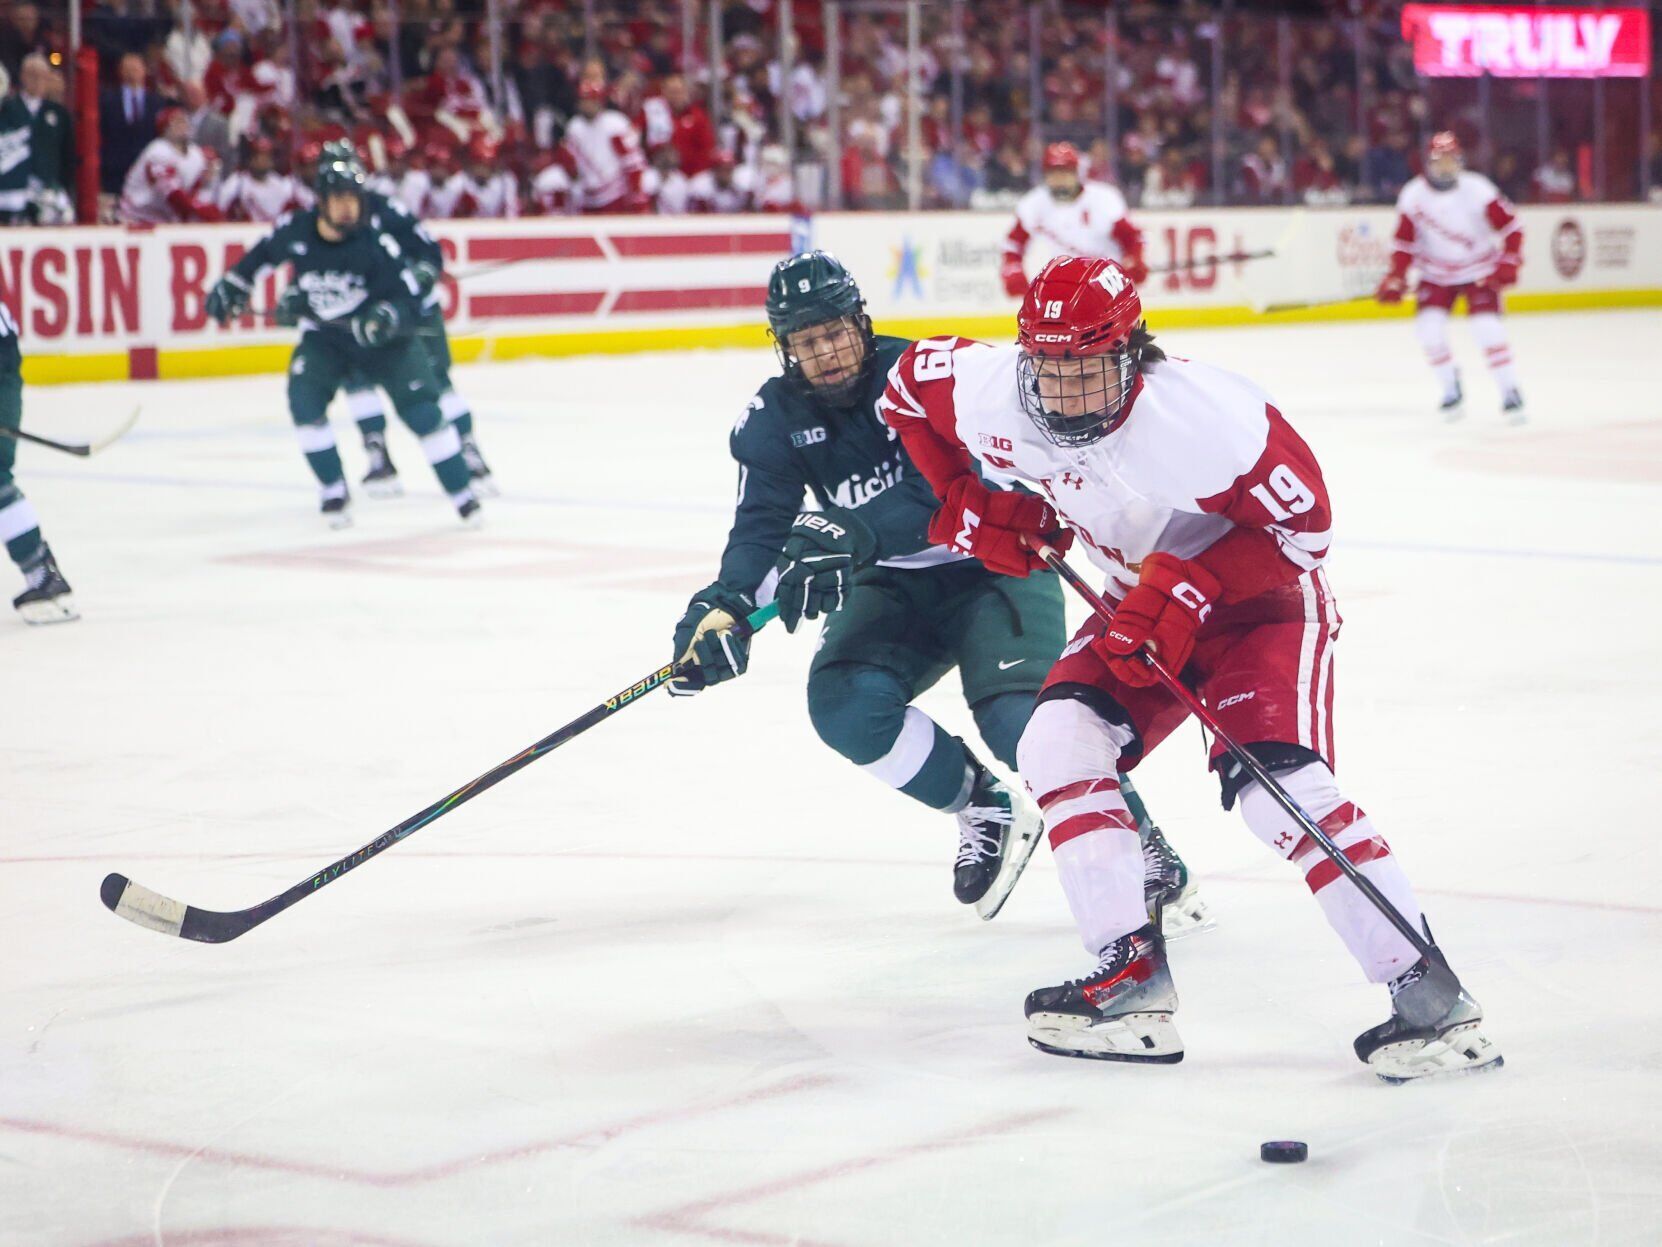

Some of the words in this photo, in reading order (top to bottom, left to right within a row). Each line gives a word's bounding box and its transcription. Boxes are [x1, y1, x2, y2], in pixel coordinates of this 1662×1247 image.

[1429, 12, 1621, 69] TRULY
[798, 278, 811, 293] 9
[1044, 301, 1063, 319] 19
[1035, 334, 1072, 344] CCM
[913, 336, 958, 382] 19
[1249, 464, 1315, 521] 19
[1109, 630, 1133, 644] CCM
[1217, 691, 1255, 711] CCM
[313, 845, 374, 889] FLYLITE
